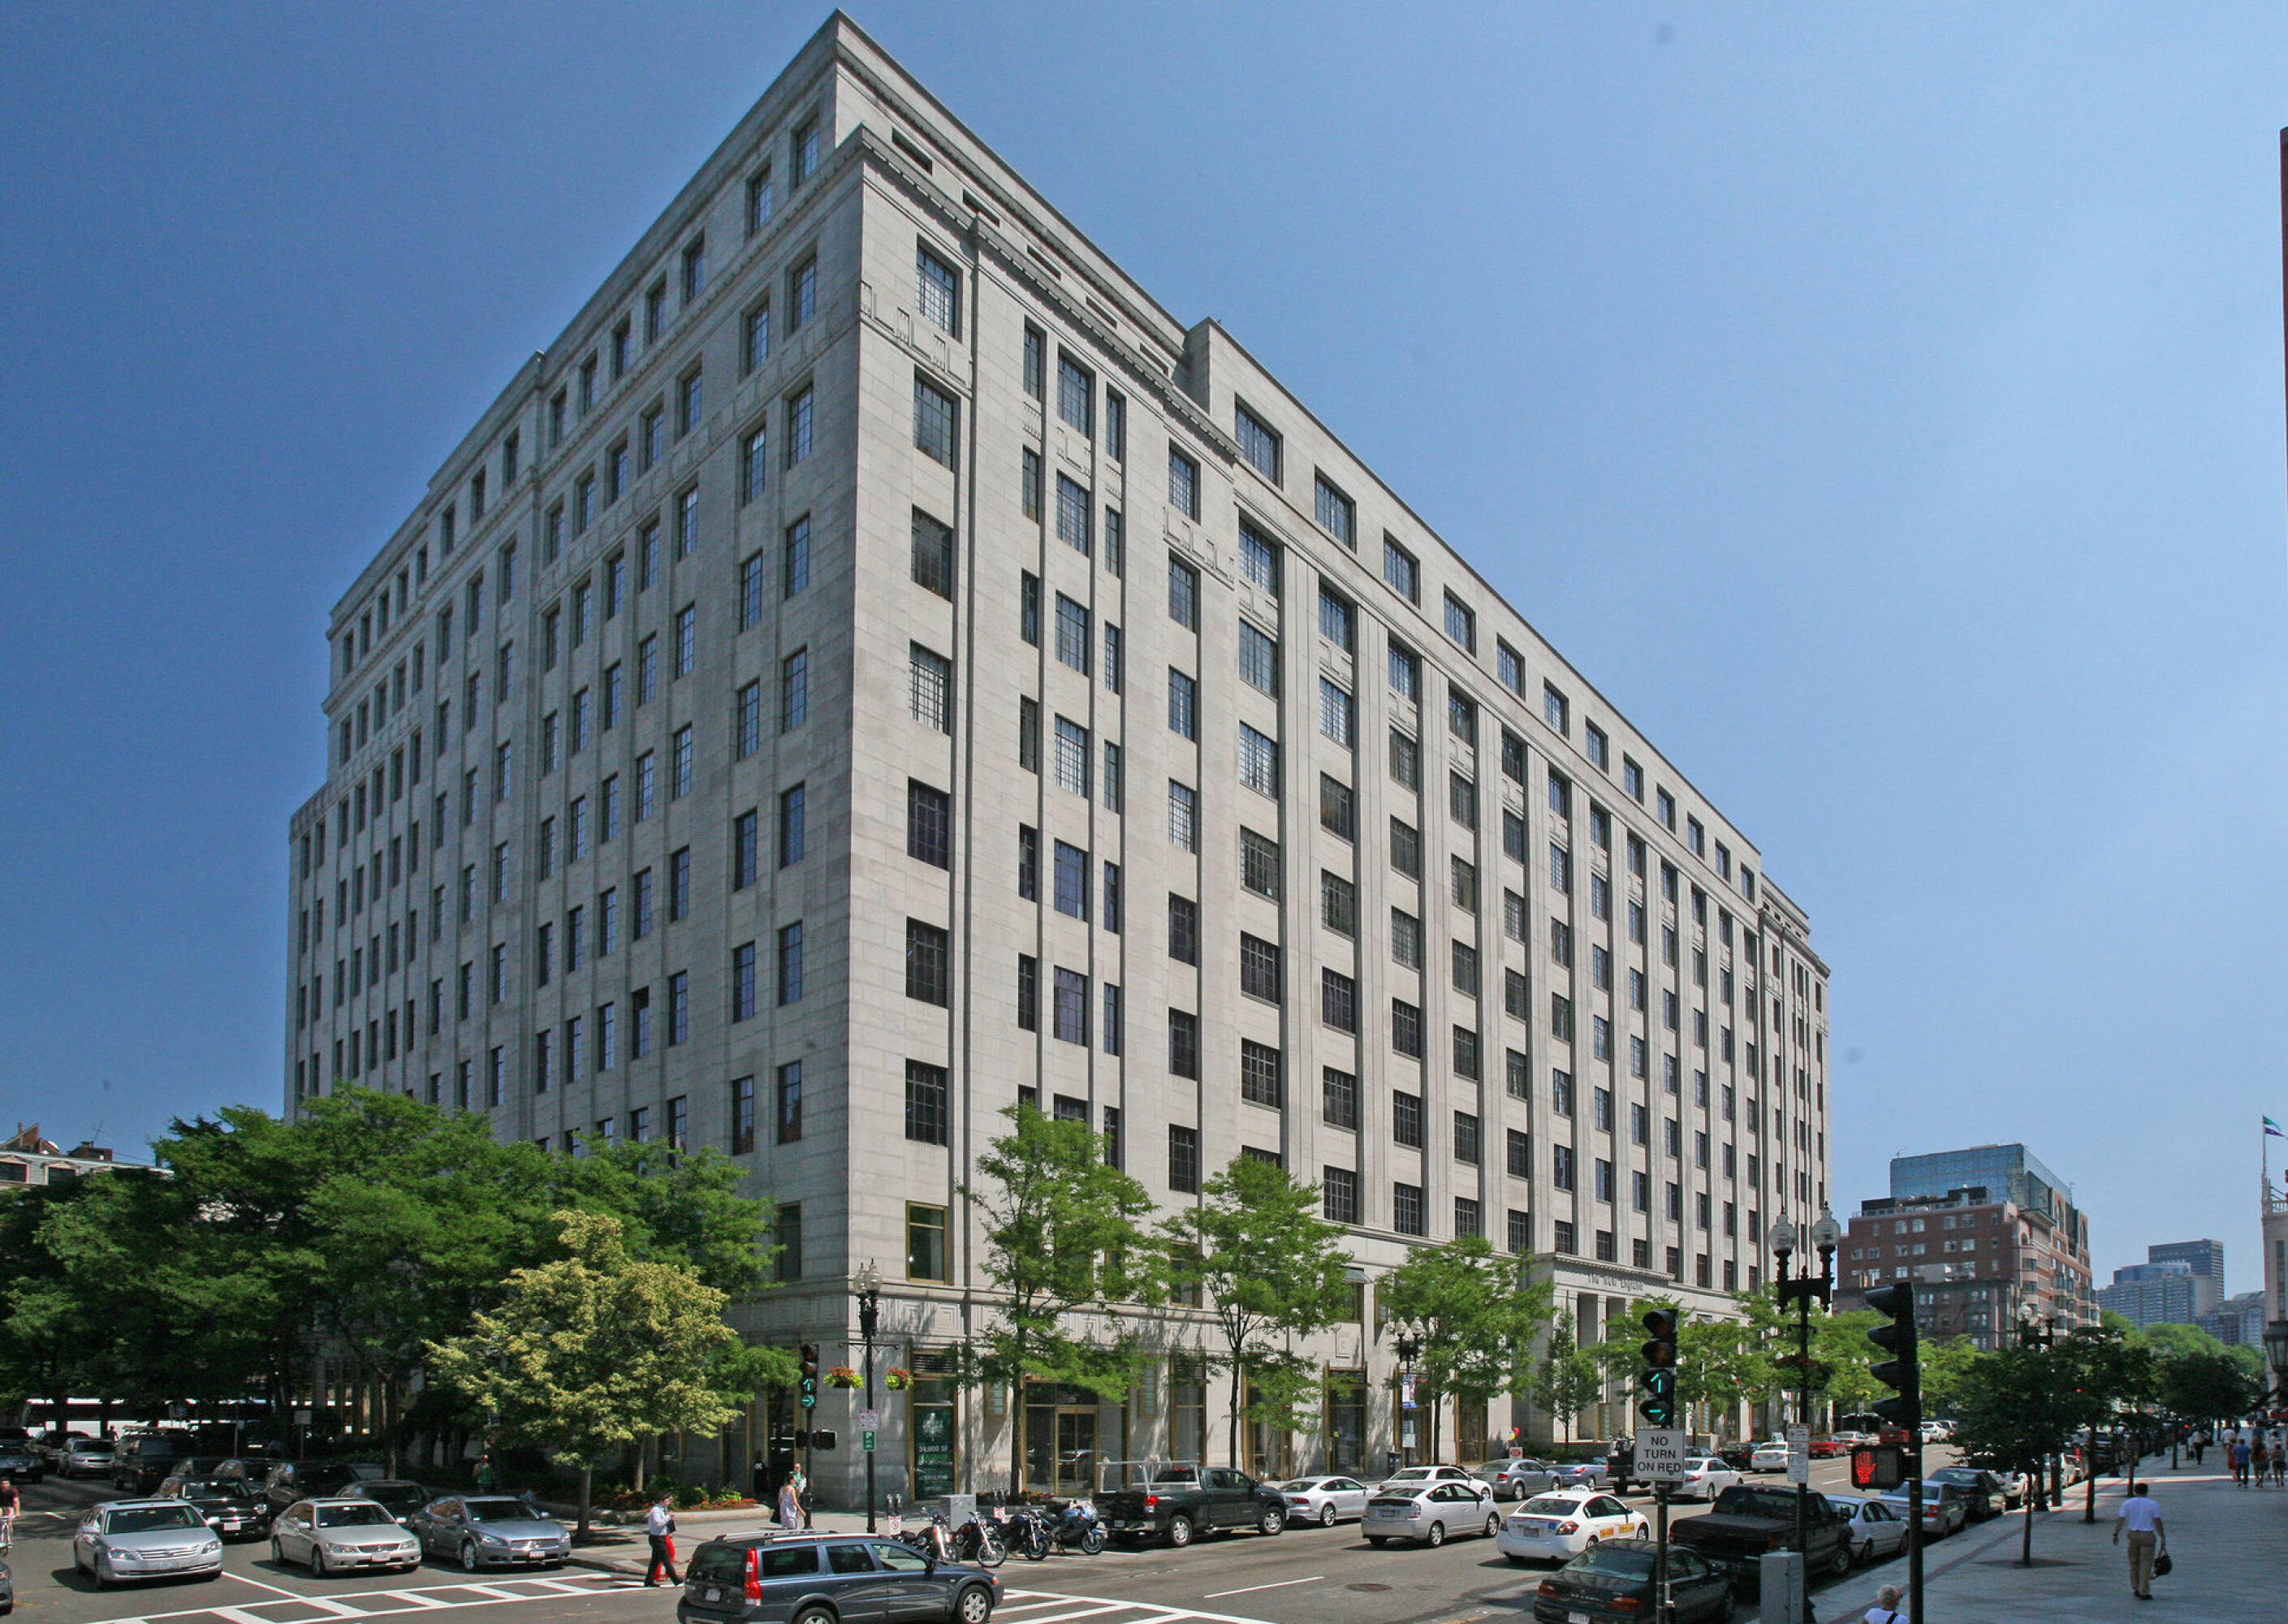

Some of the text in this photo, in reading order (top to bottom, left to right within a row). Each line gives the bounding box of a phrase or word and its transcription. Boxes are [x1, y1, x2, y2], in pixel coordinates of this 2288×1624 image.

[1651, 1436, 1669, 1446] NO
[1643, 1449, 1677, 1459] TURN
[1638, 1462, 1681, 1473] ON RED
